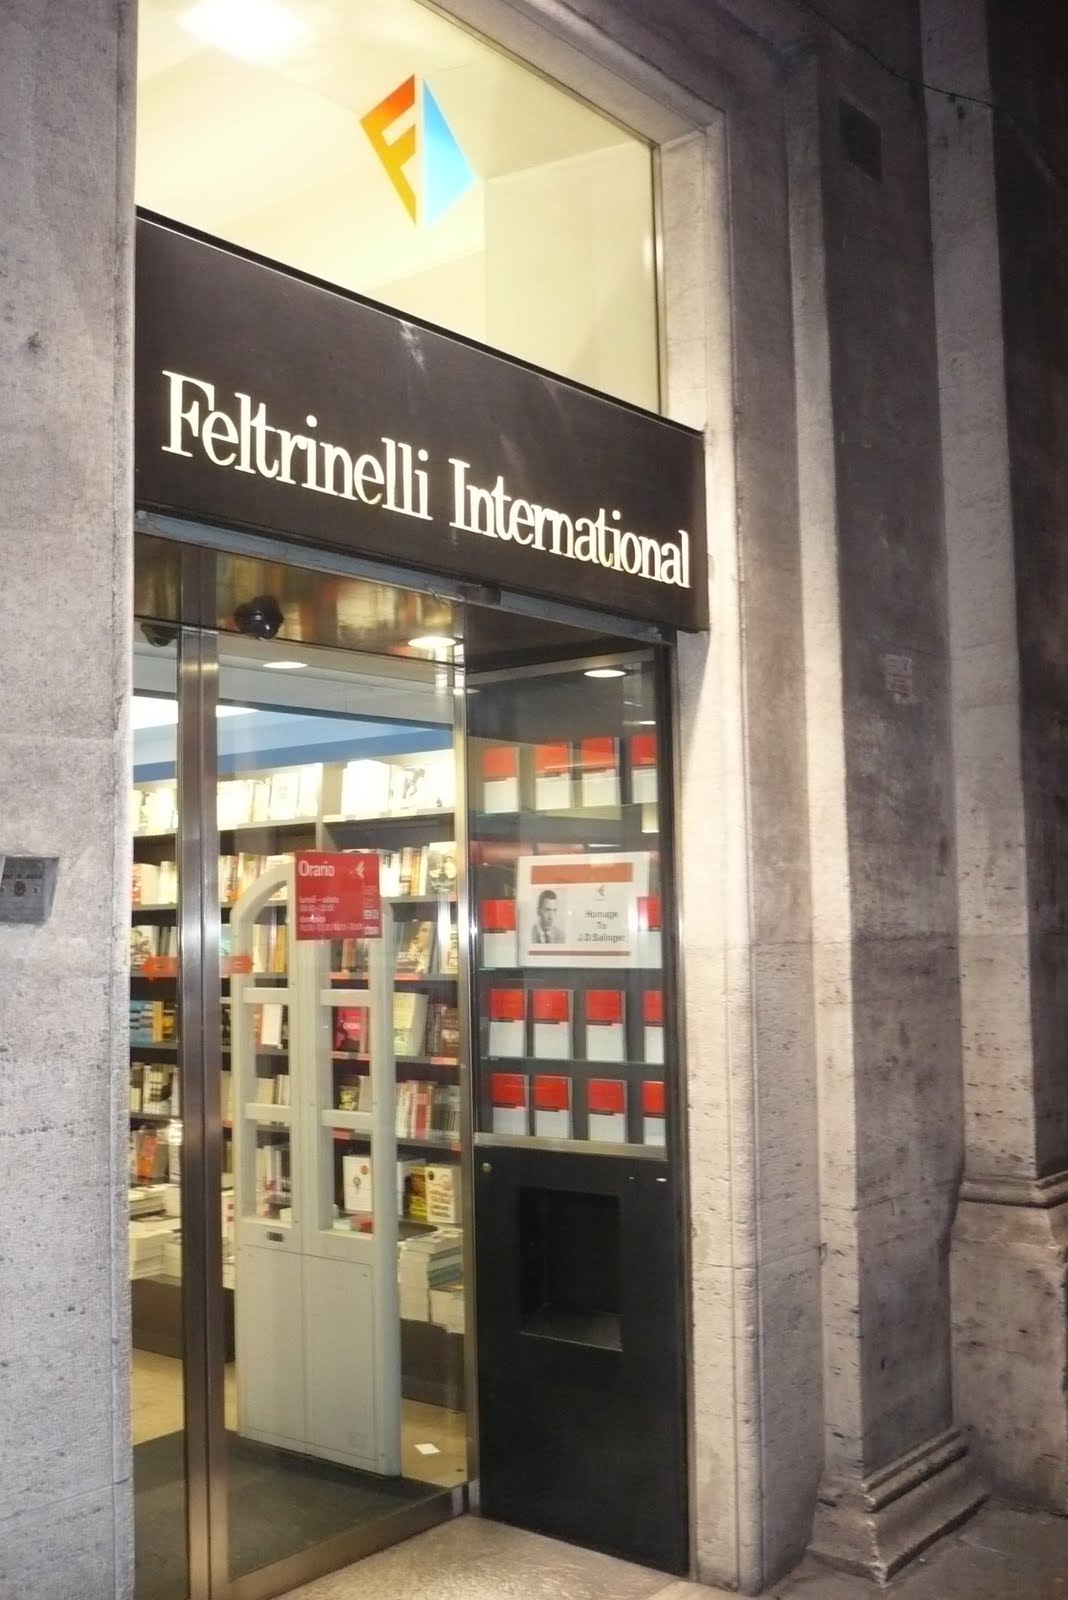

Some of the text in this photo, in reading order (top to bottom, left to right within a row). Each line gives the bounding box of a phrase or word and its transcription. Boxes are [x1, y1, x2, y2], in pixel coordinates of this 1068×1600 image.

[162, 370, 691, 588] Feltrinelli International
[299, 860, 335, 877] Orario
